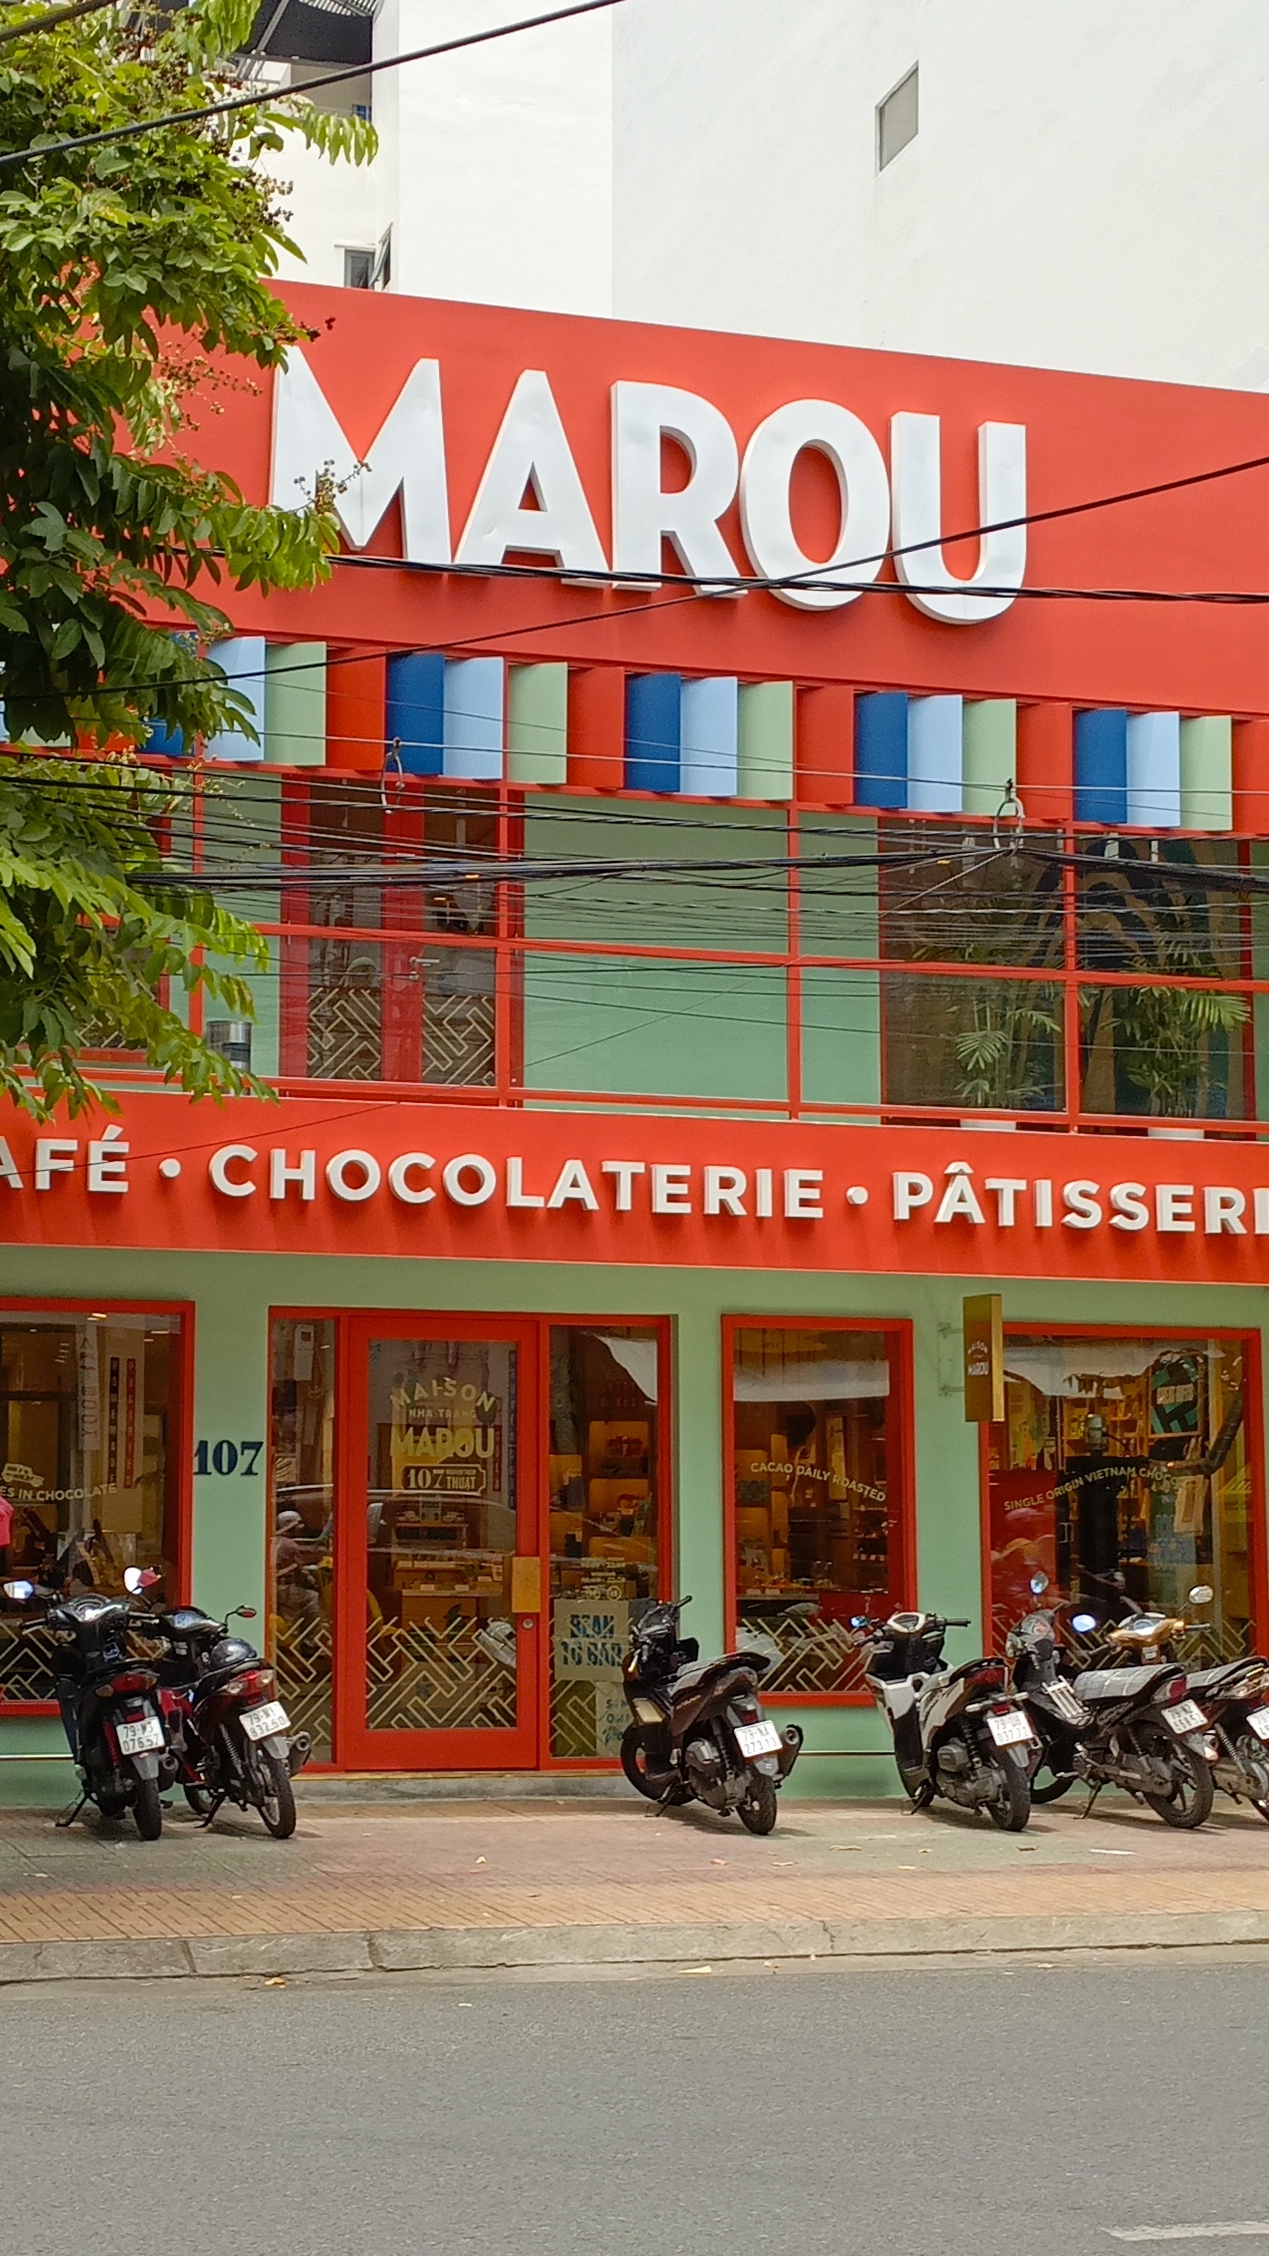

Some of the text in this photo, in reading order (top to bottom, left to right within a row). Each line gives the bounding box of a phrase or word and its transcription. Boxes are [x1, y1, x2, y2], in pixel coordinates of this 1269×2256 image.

[269, 346, 1027, 625] MAROU
[208, 1143, 824, 1219] CHOCOLATERIE
[390, 1378, 495, 1412] MAISON
[409, 1409, 433, 1418] NHA
[193, 1439, 264, 1477] 107
[390, 1427, 494, 1458] MAROU
[36, 1483, 117, 1501] CHOCOLATE
[407, 1468, 445, 1489] 107
[750, 1461, 886, 1502] CACAO DAILY ROASTED
[1004, 1493, 1044, 1511] SINGLE
[1046, 1476, 1084, 1500] ORIGIN
[1085, 1466, 1137, 1483] VIETNAM
